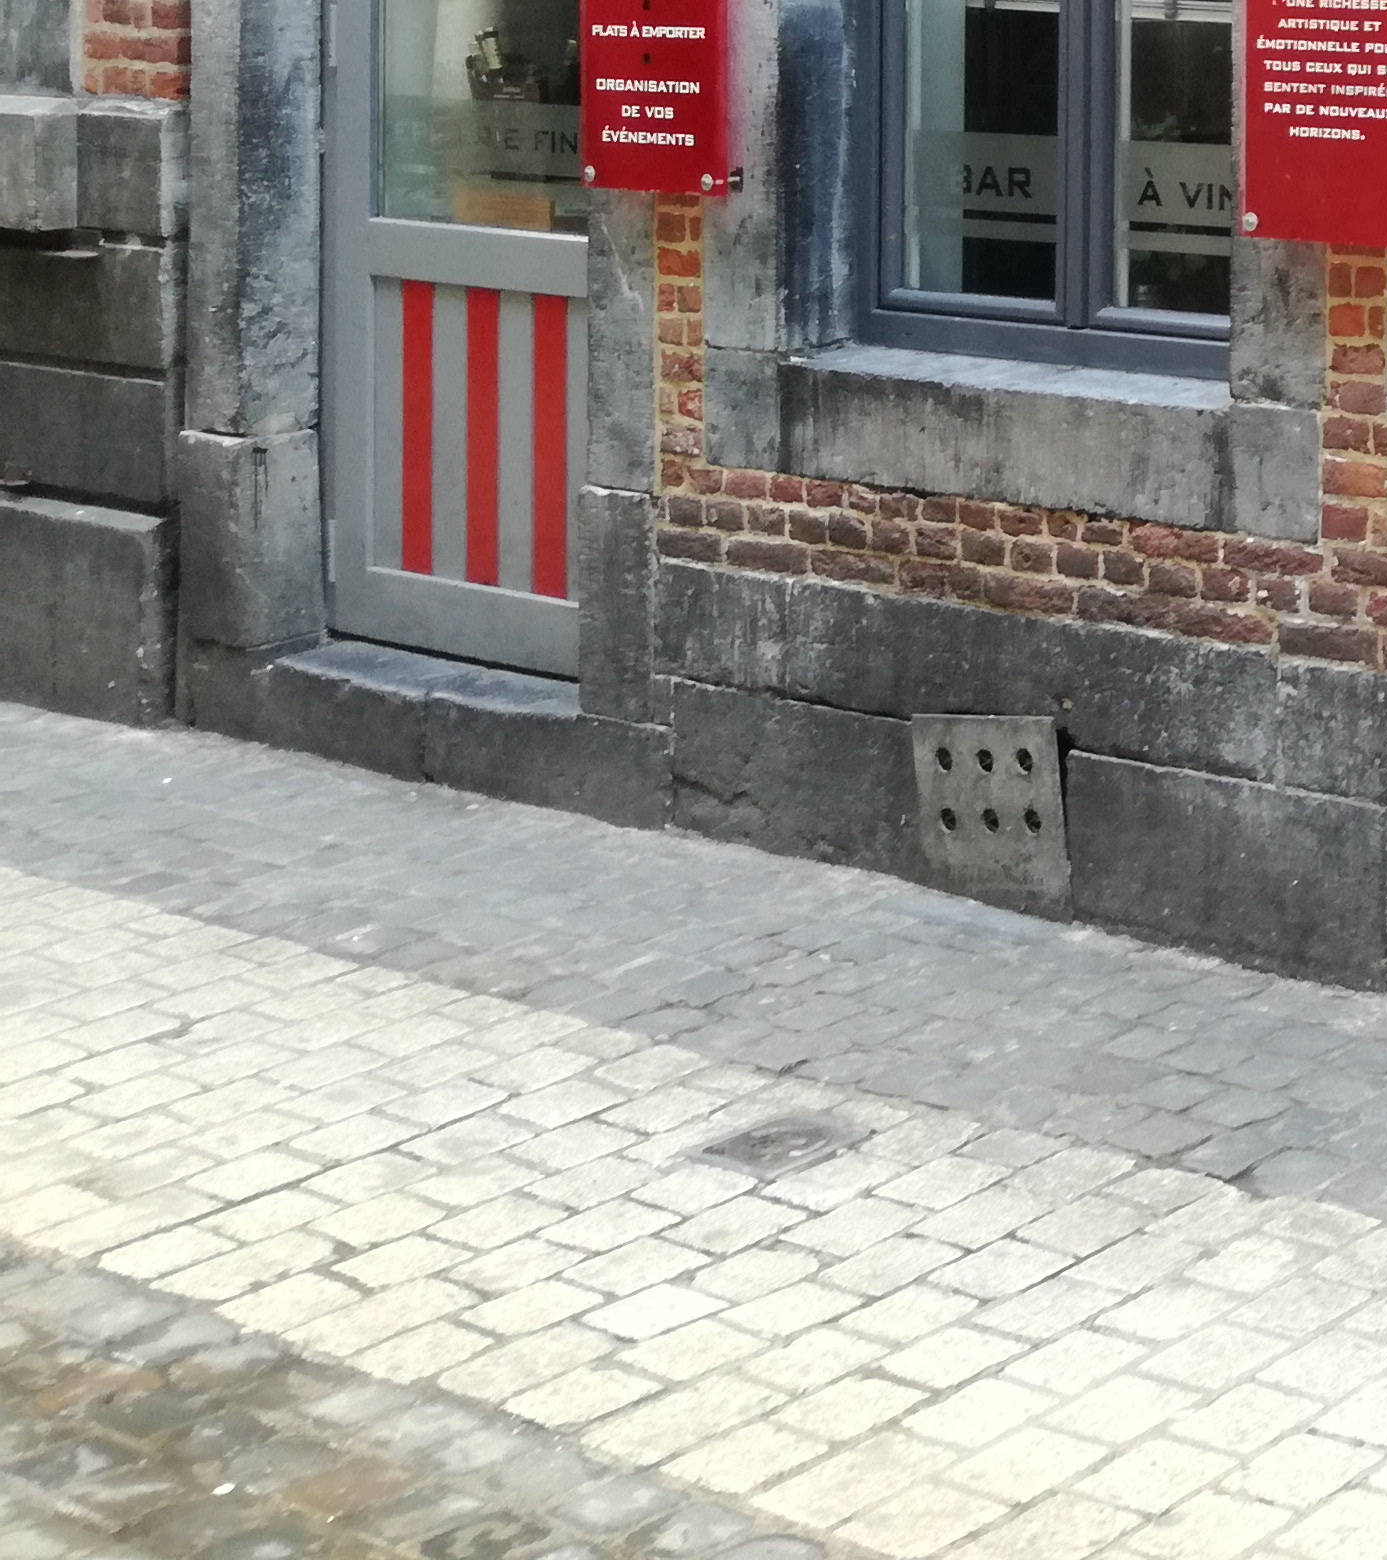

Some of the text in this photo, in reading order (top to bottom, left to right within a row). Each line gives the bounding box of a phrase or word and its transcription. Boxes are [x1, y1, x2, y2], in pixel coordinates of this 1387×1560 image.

[591, 21, 706, 39] PLATS À EMPORTER
[1277, 18, 1382, 32] ARTISTIQUE ET
[1256, 38, 1360, 53] ÉMOTIONNELLE
[1263, 59, 1301, 72] TOUS
[1305, 61, 1343, 74] CEUX
[1346, 63, 1372, 76] QUI
[595, 78, 700, 94] ORGANISATION
[1263, 81, 1327, 94] SENTENT
[621, 104, 674, 120] DE VOS
[1263, 102, 1292, 114] PAR
[1295, 104, 1315, 116] DE
[601, 126, 695, 147] ÉVÉNEMENTS
[1289, 126, 1366, 141] HORIZONS.
[1137, 167, 1162, 207] À
